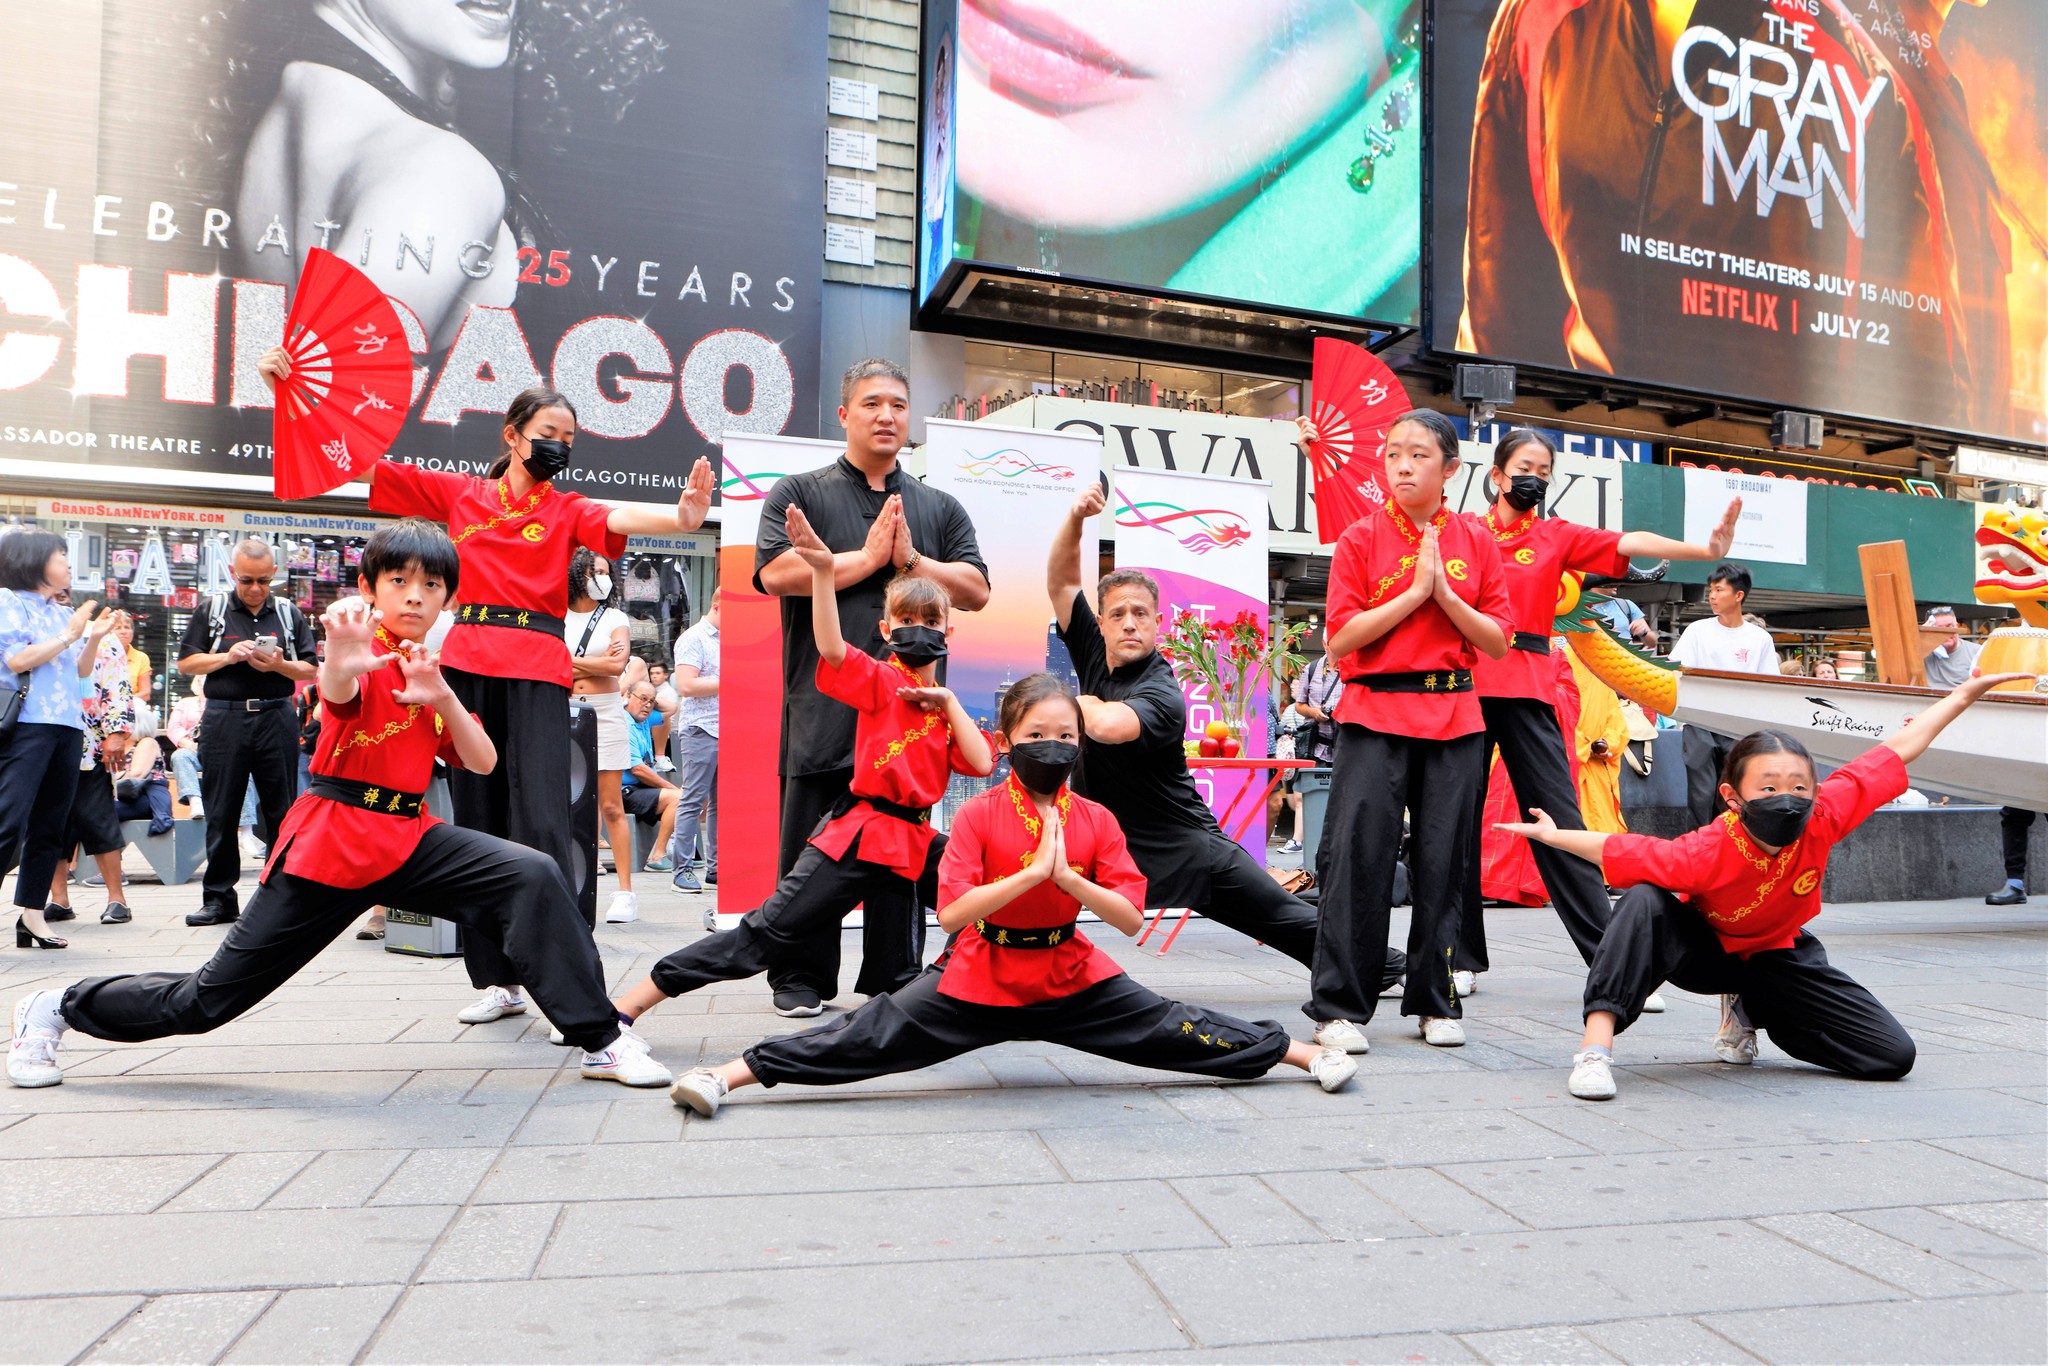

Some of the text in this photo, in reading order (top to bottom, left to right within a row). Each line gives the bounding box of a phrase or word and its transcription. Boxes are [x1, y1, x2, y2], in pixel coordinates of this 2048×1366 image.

[1762, 12, 1816, 53] THE
[1671, 24, 1889, 153] GRAY
[1702, 115, 1866, 240] MAN
[516, 246, 571, 288] 25
[590, 254, 796, 313] YEARS
[1621, 233, 1942, 315] IN SELECT THEATERS JULY 15 AND ON
[1681, 278, 1779, 332] NETFLIX
[0, 250, 795, 447] CHIAGO
[1810, 311, 1890, 345] JULY 22
[0, 426, 97, 447] SSADOR
[108, 434, 201, 455] THEATRE
[228, 443, 275, 460] 49TH
[953, 476, 973, 484] HONG
[974, 478, 993, 486] KONG
[993, 480, 1025, 489] ECONOMIC
[1032, 483, 1053, 491] TRADE
[1054, 485, 1076, 493] OFFICE
[1725, 478, 1772, 493] 1567 BROADWAY
[625, 536, 697, 550] EWYORK.COM
[1811, 710, 1885, 737] Swift Racing
